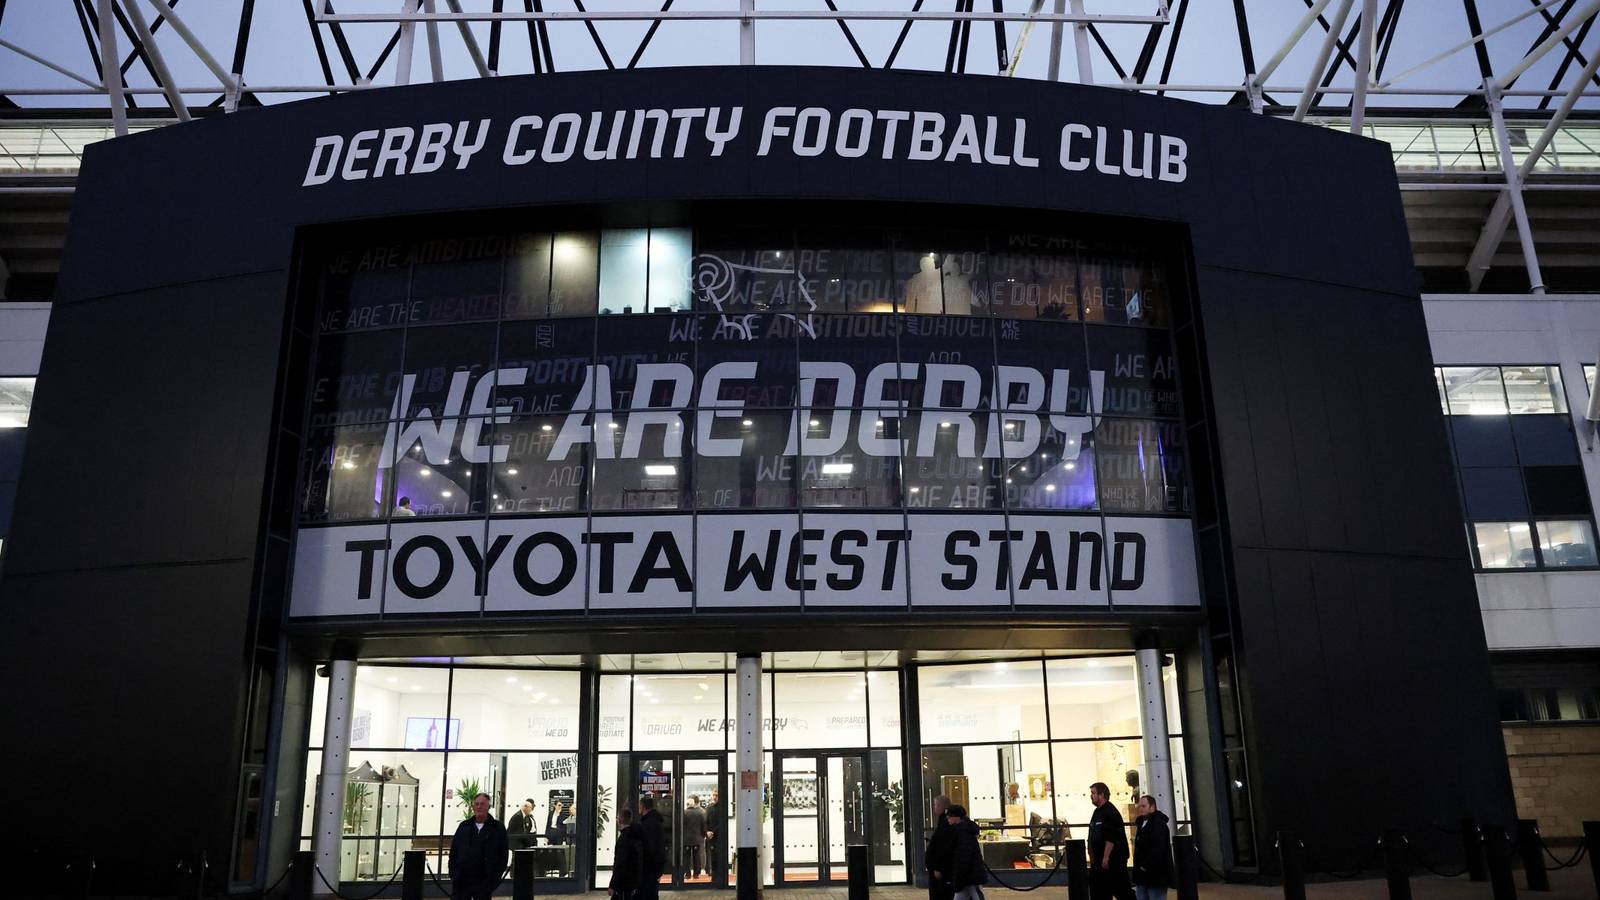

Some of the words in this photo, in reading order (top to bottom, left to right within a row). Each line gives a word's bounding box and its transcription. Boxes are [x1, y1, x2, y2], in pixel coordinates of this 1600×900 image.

[302, 119, 491, 187] DERBY
[502, 107, 743, 166] COUNTY
[756, 107, 1040, 168] FOOTBALL
[1059, 123, 1189, 184] CLUB
[729, 280, 767, 305] WE
[1047, 285, 1076, 306] WE
[1081, 287, 1115, 309] ARE
[345, 305, 384, 329] ARE
[389, 301, 423, 321] THE
[668, 316, 703, 342] WE
[1115, 354, 1145, 378] WE
[377, 368, 528, 469] WE
[547, 362, 757, 461] ARE
[783, 361, 1105, 462] DERBY
[546, 465, 584, 487] AND
[756, 455, 792, 481] WE
[345, 531, 693, 600] TOYOTA
[724, 530, 911, 592] WEST
[941, 530, 1146, 590] STAND
[647, 723, 682, 735] DRIVEN
[697, 718, 715, 731] WE
[718, 718, 736, 731] AR
[762, 718, 787, 730] RBY
[541, 759, 555, 770] WE
[556, 757, 572, 767] ARE
[541, 766, 572, 781] DERBY
